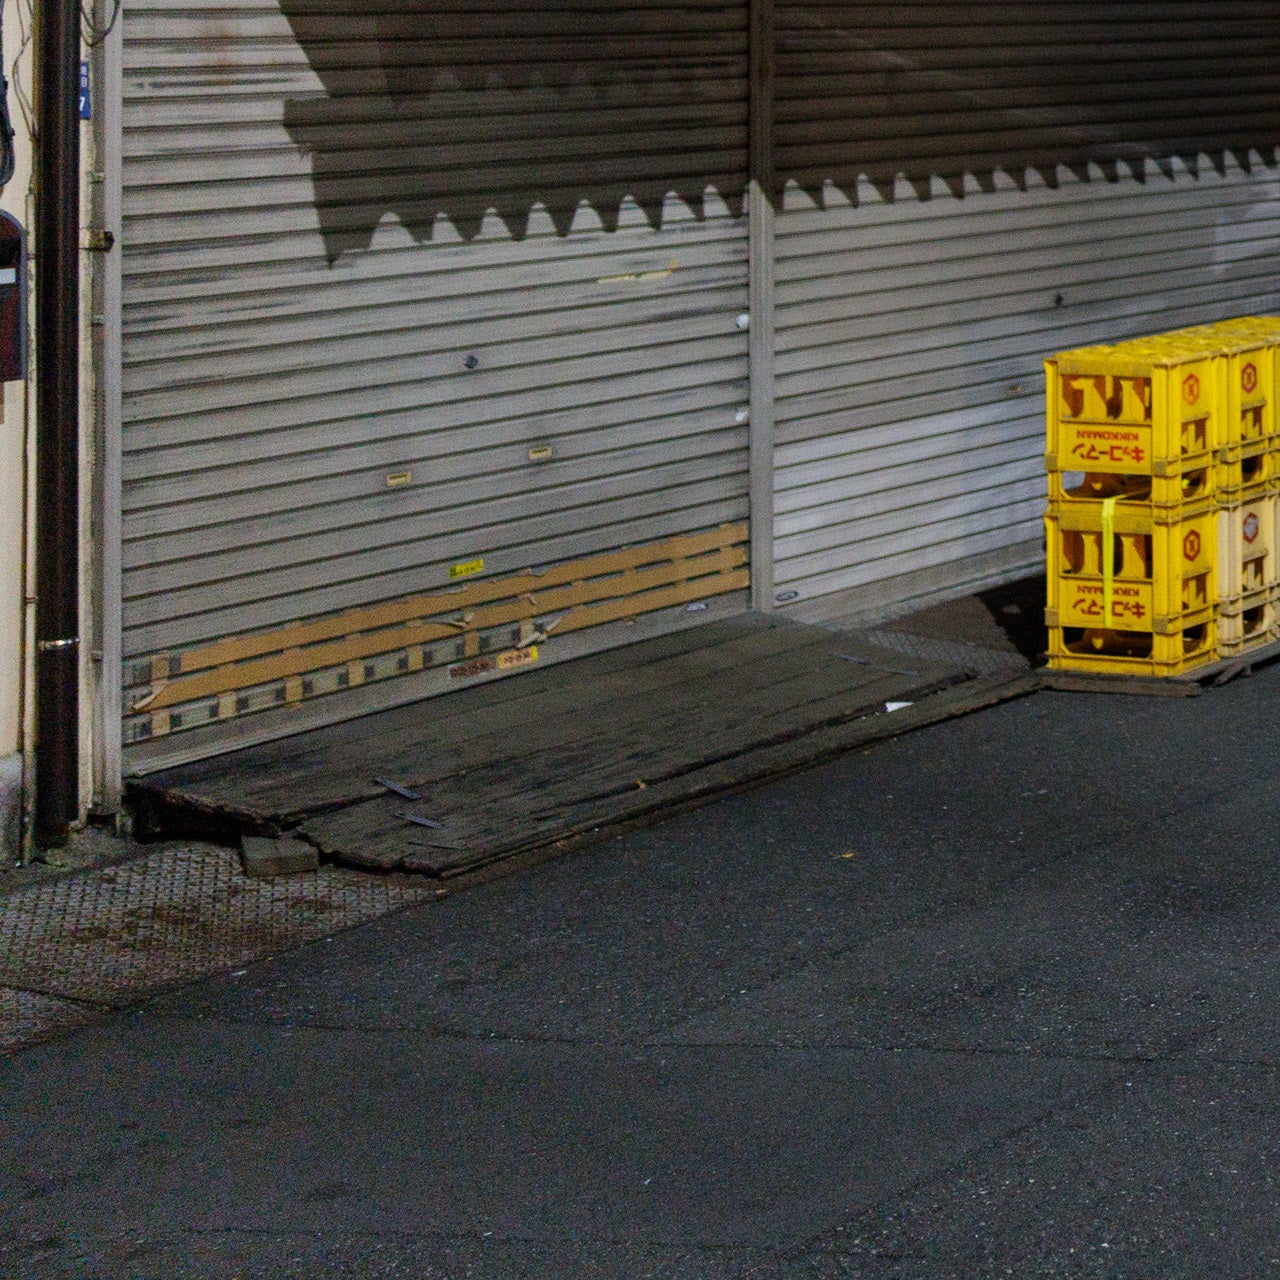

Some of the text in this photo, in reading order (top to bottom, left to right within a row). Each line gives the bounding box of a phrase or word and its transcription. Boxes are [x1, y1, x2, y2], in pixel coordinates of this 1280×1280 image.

[1076, 428, 1140, 441] KIKKOMAN
[1072, 442, 1145, 463] キッコーマン
[1076, 584, 1140, 598] KIKKMAN
